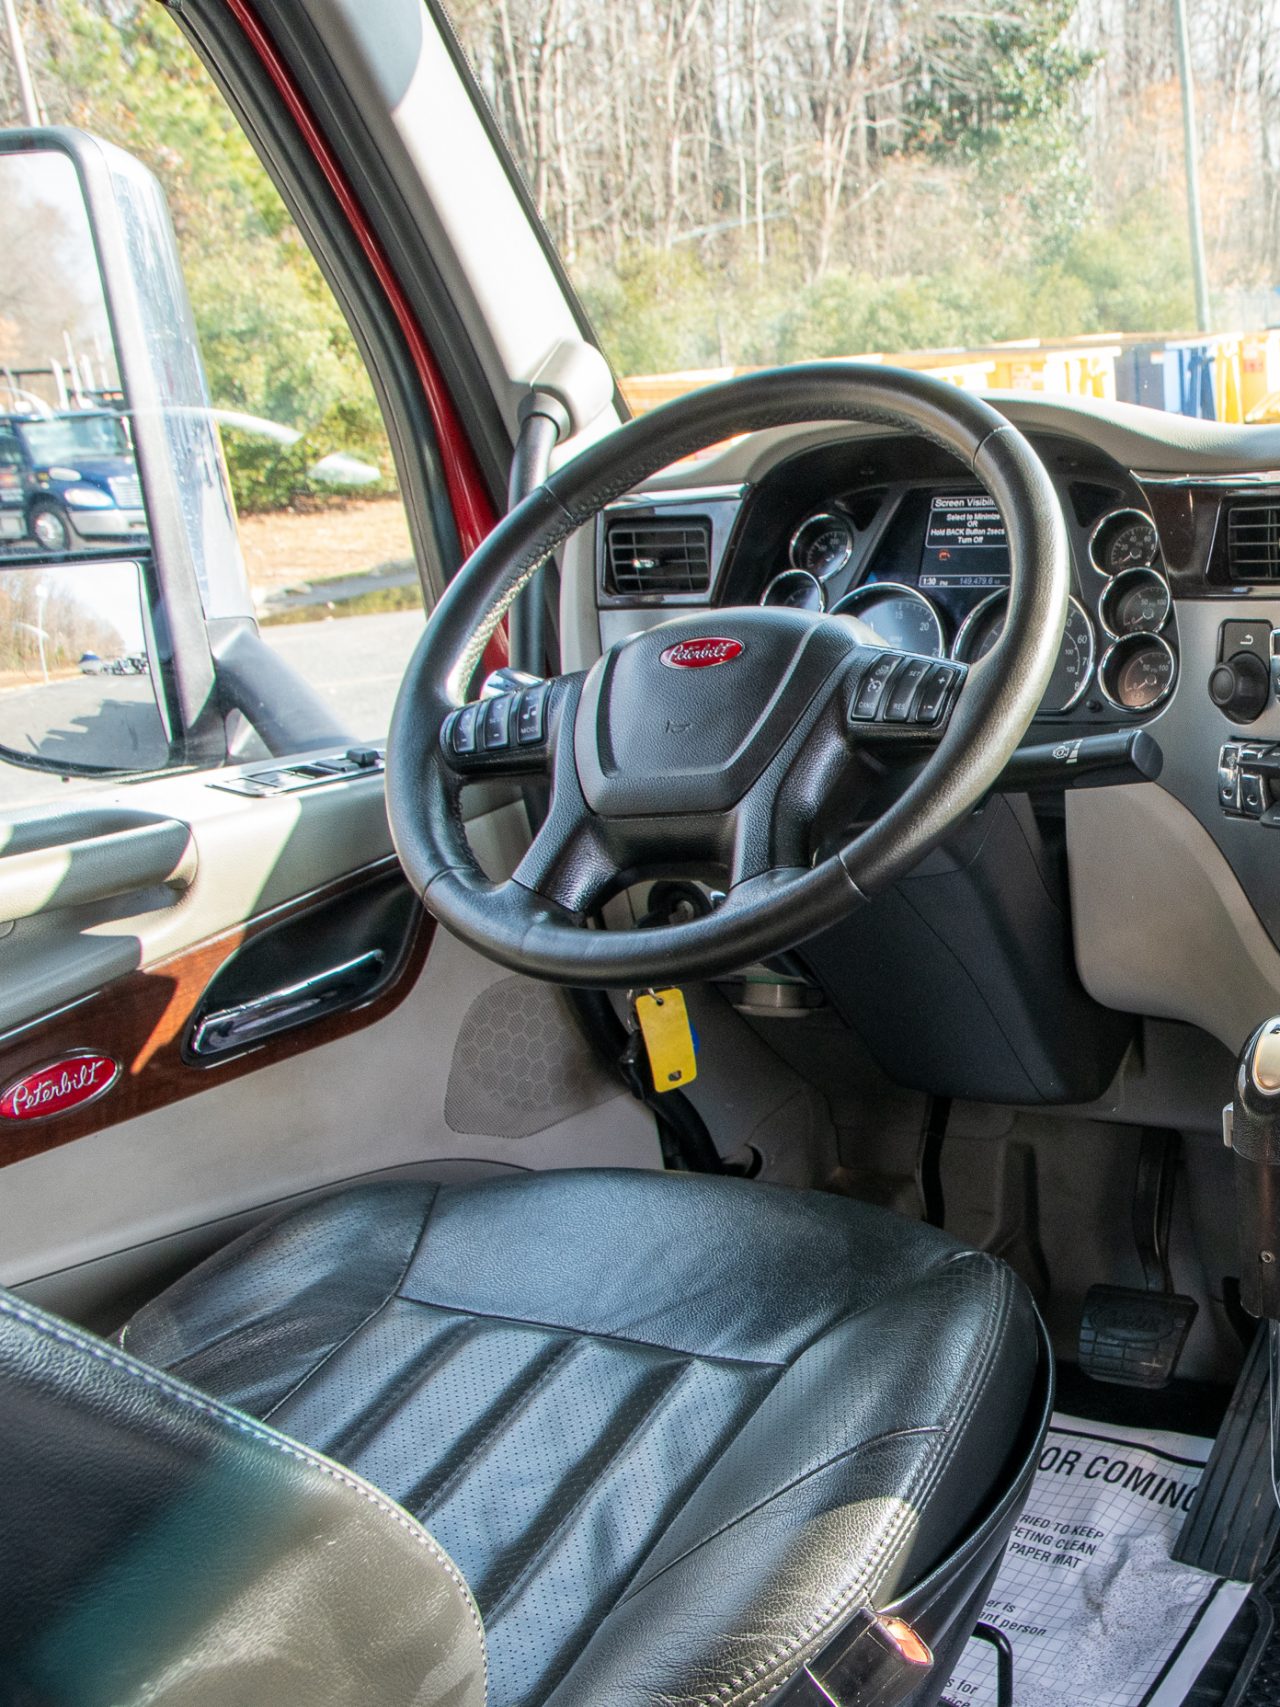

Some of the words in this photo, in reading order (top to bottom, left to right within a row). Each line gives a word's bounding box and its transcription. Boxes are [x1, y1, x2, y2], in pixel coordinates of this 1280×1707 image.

[935, 499, 964, 508] Screen
[920, 622, 929, 632] 20
[1078, 634, 1088, 644] 60
[668, 642, 736, 661] Peterbilt
[13, 1060, 105, 1115] Peterbilt
[1038, 1446, 1082, 1476] OR
[1020, 1514, 1050, 1528] RIED
[1053, 1522, 1070, 1535] TO
[1071, 1525, 1104, 1539] KEEP
[1009, 1542, 1051, 1562] PAPER
[1052, 1554, 1082, 1568] MAT
[1055, 1539, 1096, 1556] CLEAN
[1002, 1602, 1016, 1613] is
[979, 1611, 1000, 1624] ant
[999, 1619, 1047, 1636] person
[957, 1680, 978, 1695] for
